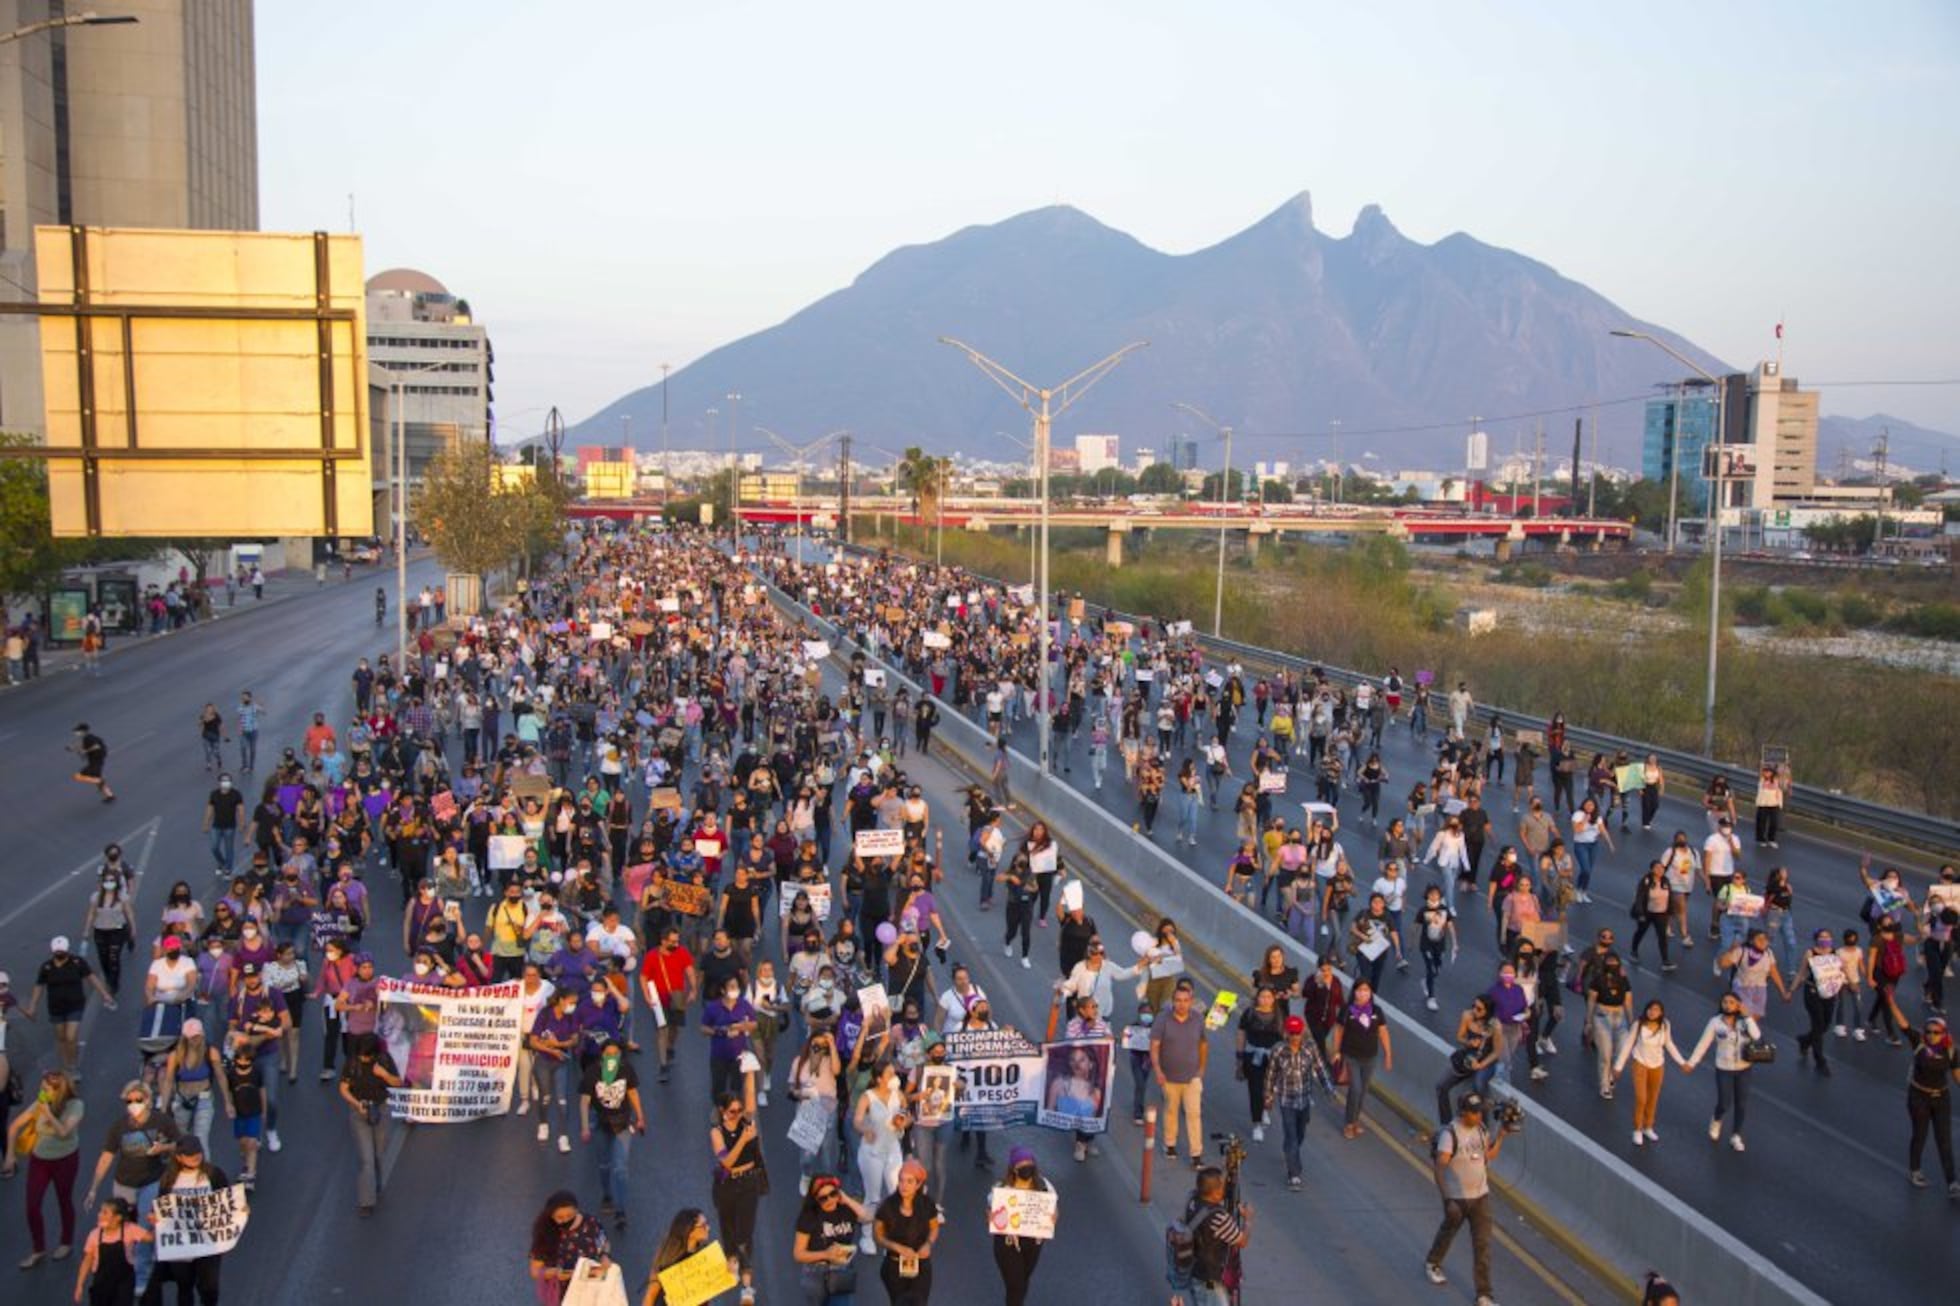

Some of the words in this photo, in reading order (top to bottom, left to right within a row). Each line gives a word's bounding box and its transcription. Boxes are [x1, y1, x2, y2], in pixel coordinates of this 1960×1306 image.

[440, 1053, 511, 1068] FEMINICIDIO
[978, 1088, 1020, 1101] PESOS
[173, 1220, 182, 1231] A
[185, 1213, 234, 1231] LUCHAR
